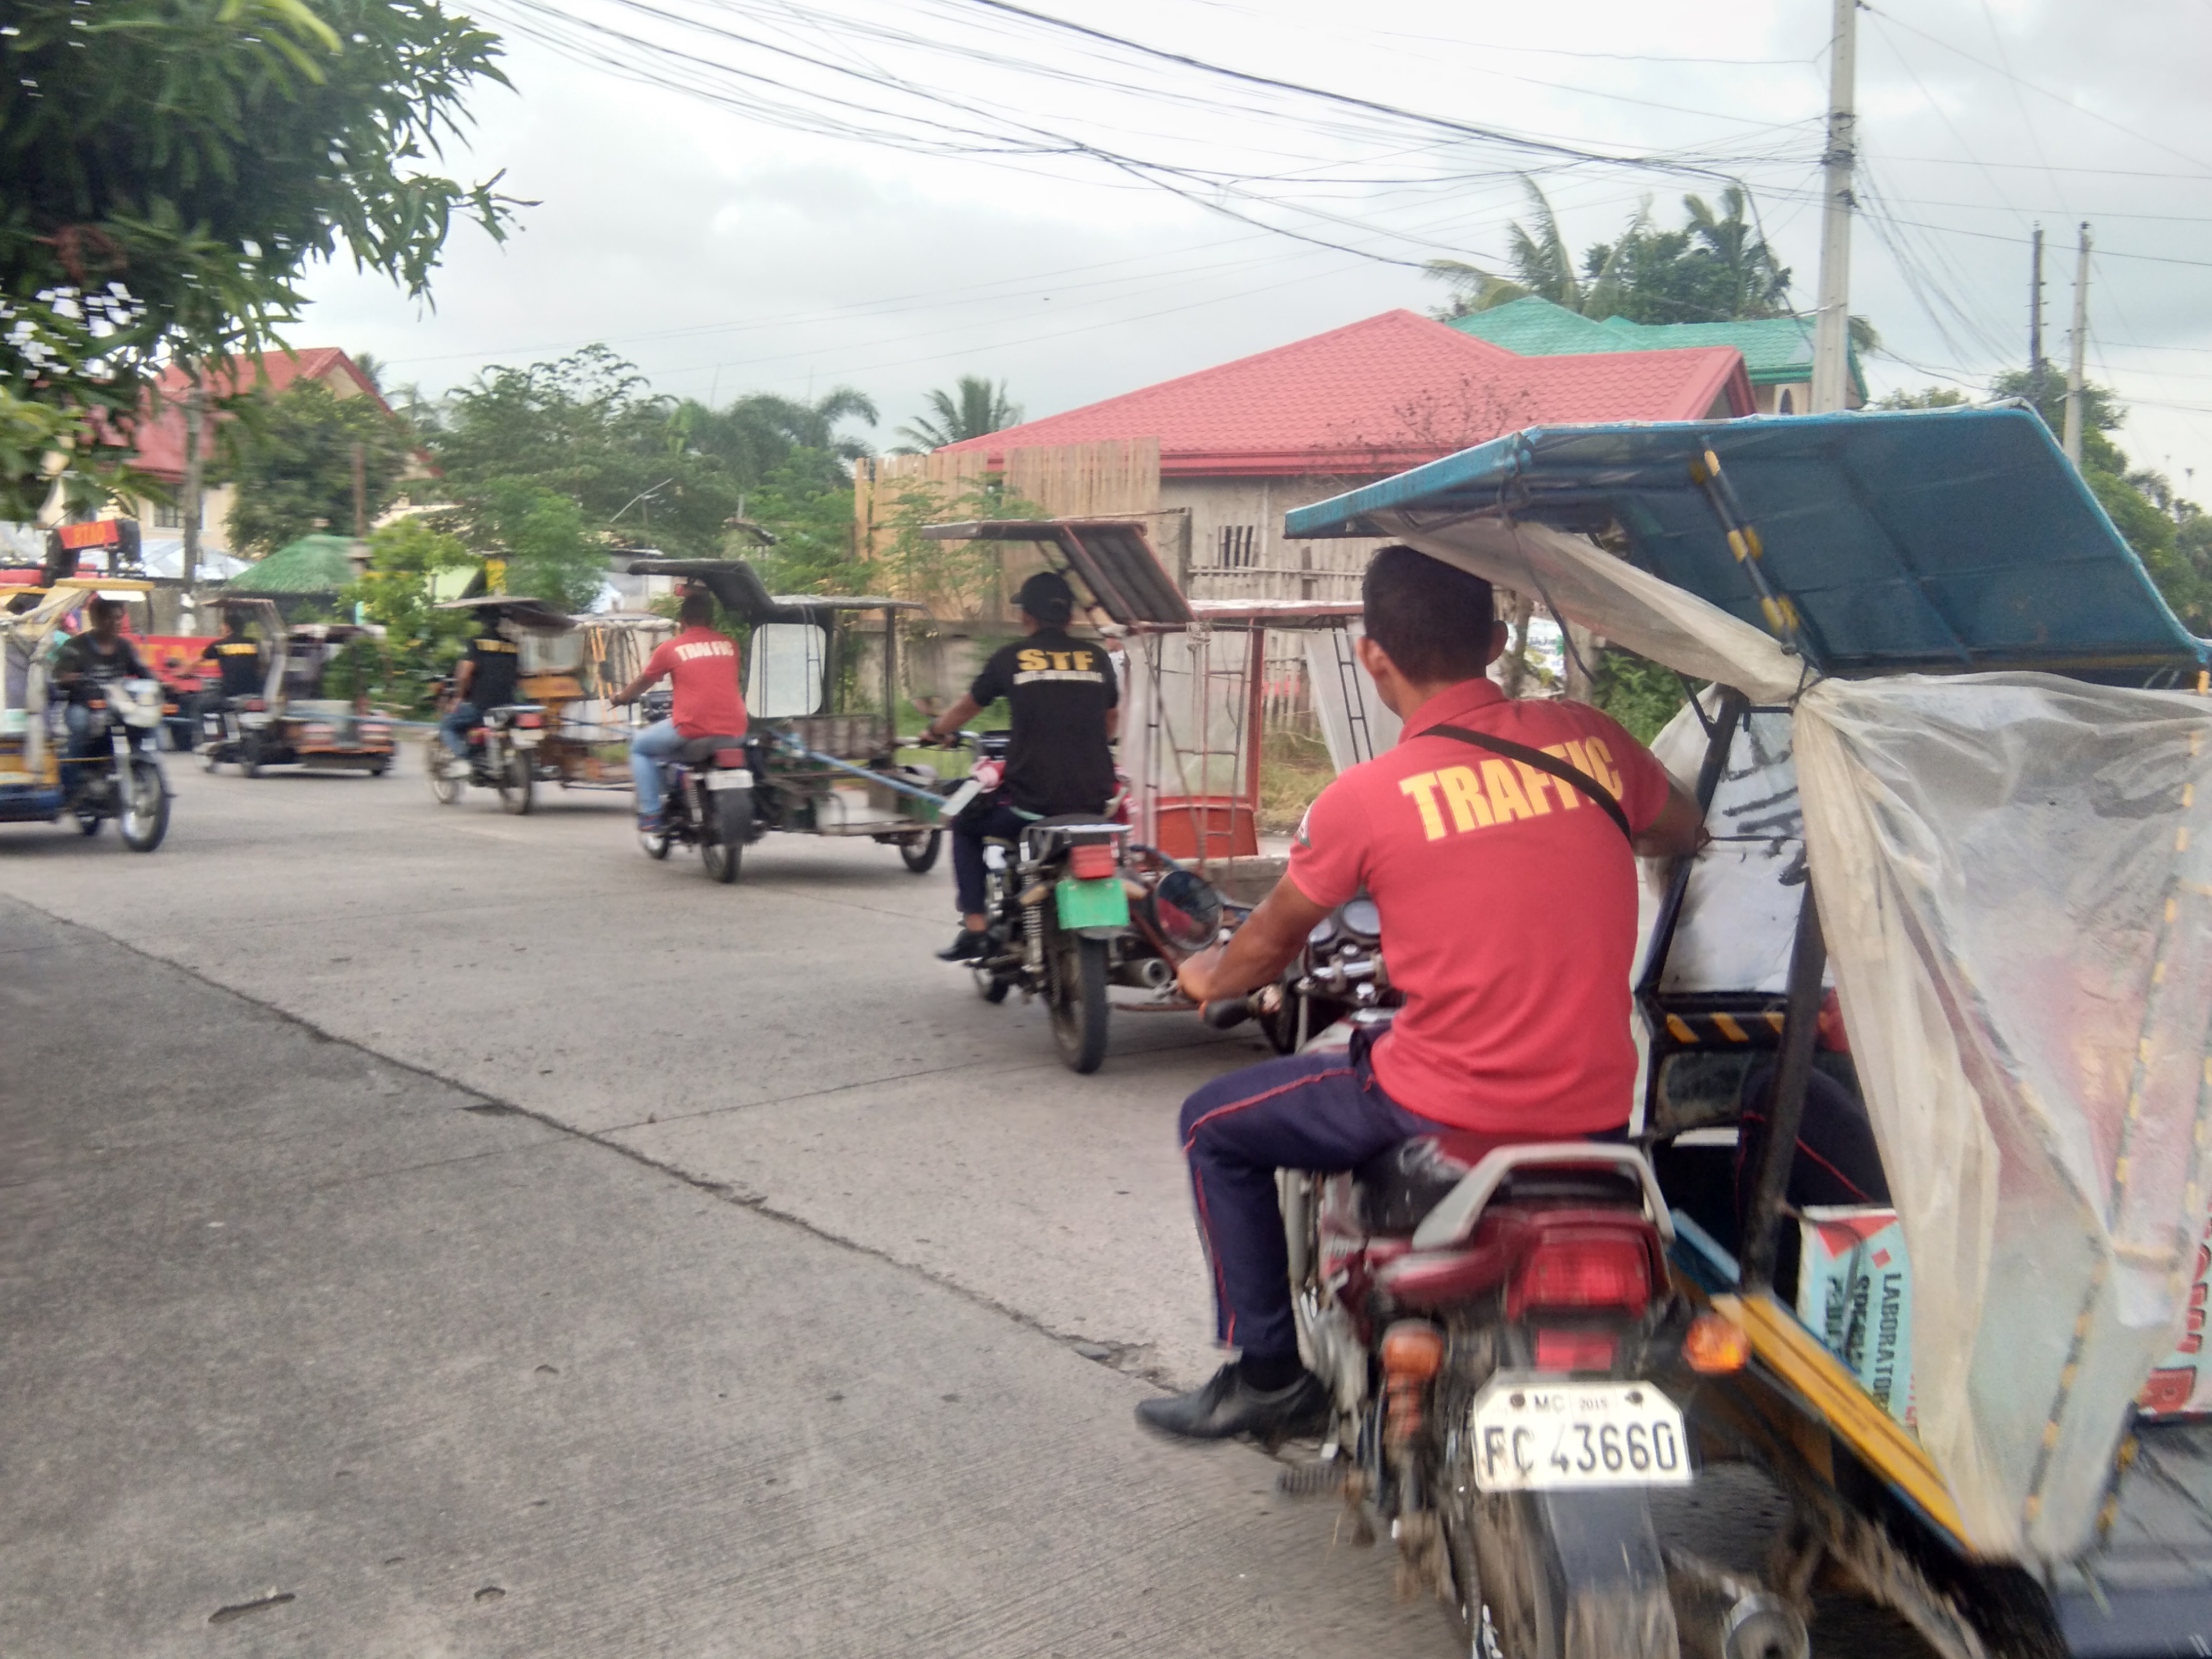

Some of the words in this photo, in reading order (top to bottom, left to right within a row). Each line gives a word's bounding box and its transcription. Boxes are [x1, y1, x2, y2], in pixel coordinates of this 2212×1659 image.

[1016, 648, 1093, 671] STF
[1873, 1272, 1902, 1411] LABORATOR
[1534, 1393, 1565, 1415] MC
[1548, 1421, 1677, 1473] 43660
